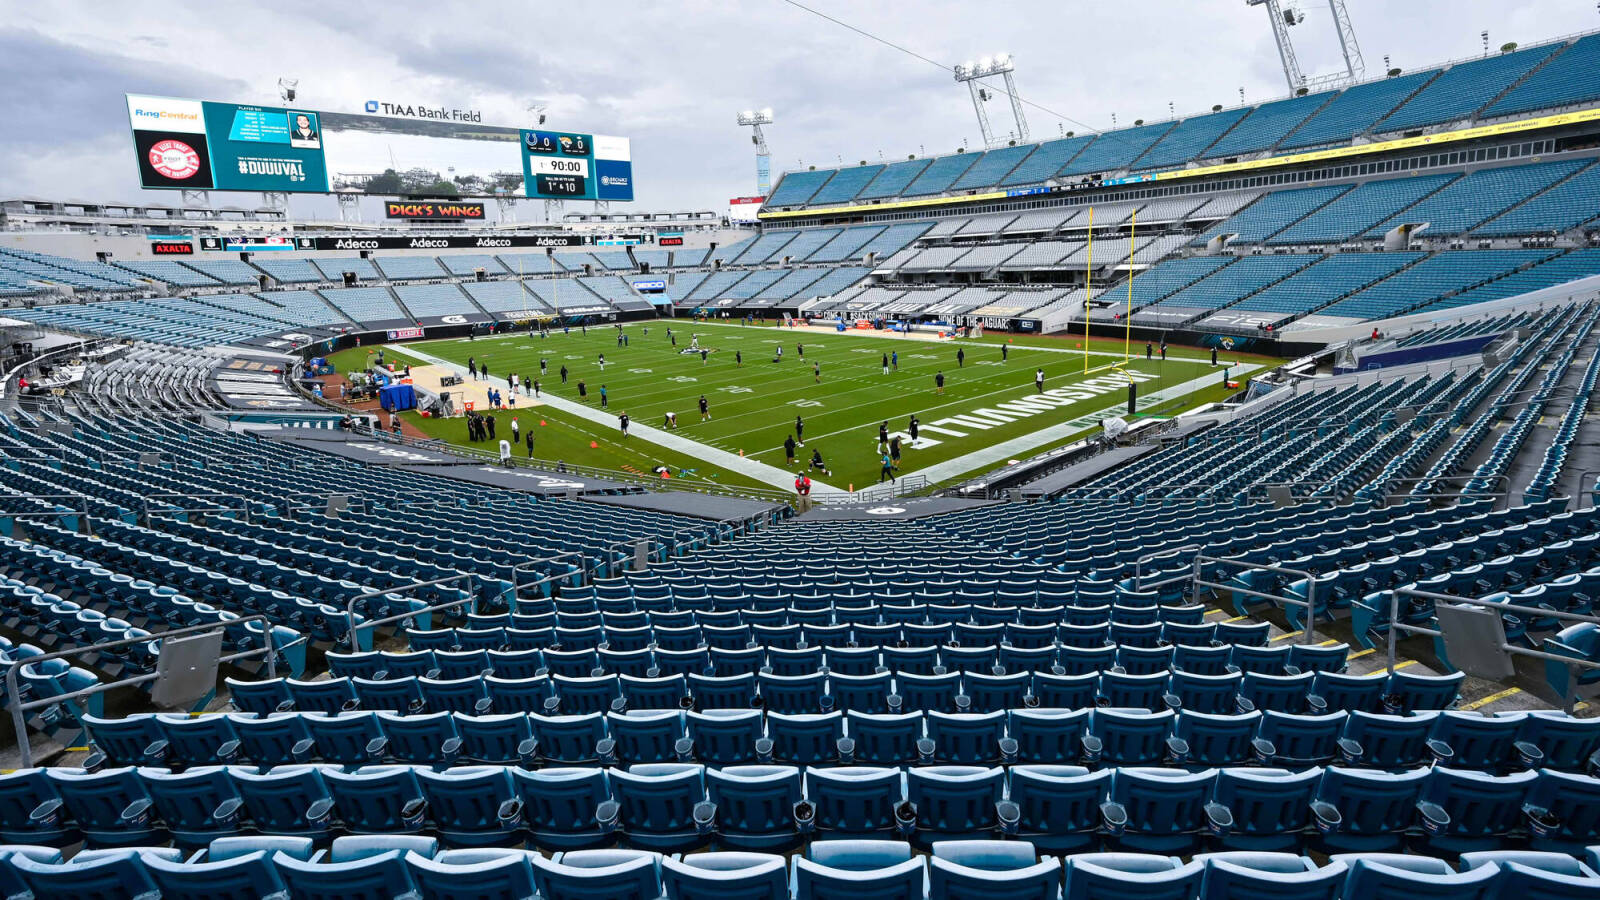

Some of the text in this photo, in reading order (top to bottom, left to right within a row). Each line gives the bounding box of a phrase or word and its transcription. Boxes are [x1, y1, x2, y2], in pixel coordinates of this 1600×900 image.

[135, 108, 198, 120] RingCentral
[380, 102, 482, 123] TIAA Bank Field
[543, 137, 550, 147] 0
[577, 140, 583, 149] 0
[238, 161, 305, 176] #DUUUVAL
[551, 160, 581, 172] 90:00
[565, 182, 576, 192] 10
[389, 203, 482, 217] DICK'S WINGS
[335, 238, 379, 249] Adecco
[409, 237, 449, 248] Adecco
[476, 237, 511, 247] Adecco
[535, 236, 568, 246] Adecco
[155, 244, 191, 253] AXALTA
[956, 315, 965, 325] OF
[966, 316, 978, 327] THE
[877, 368, 1161, 451] JACKSONVILLE
